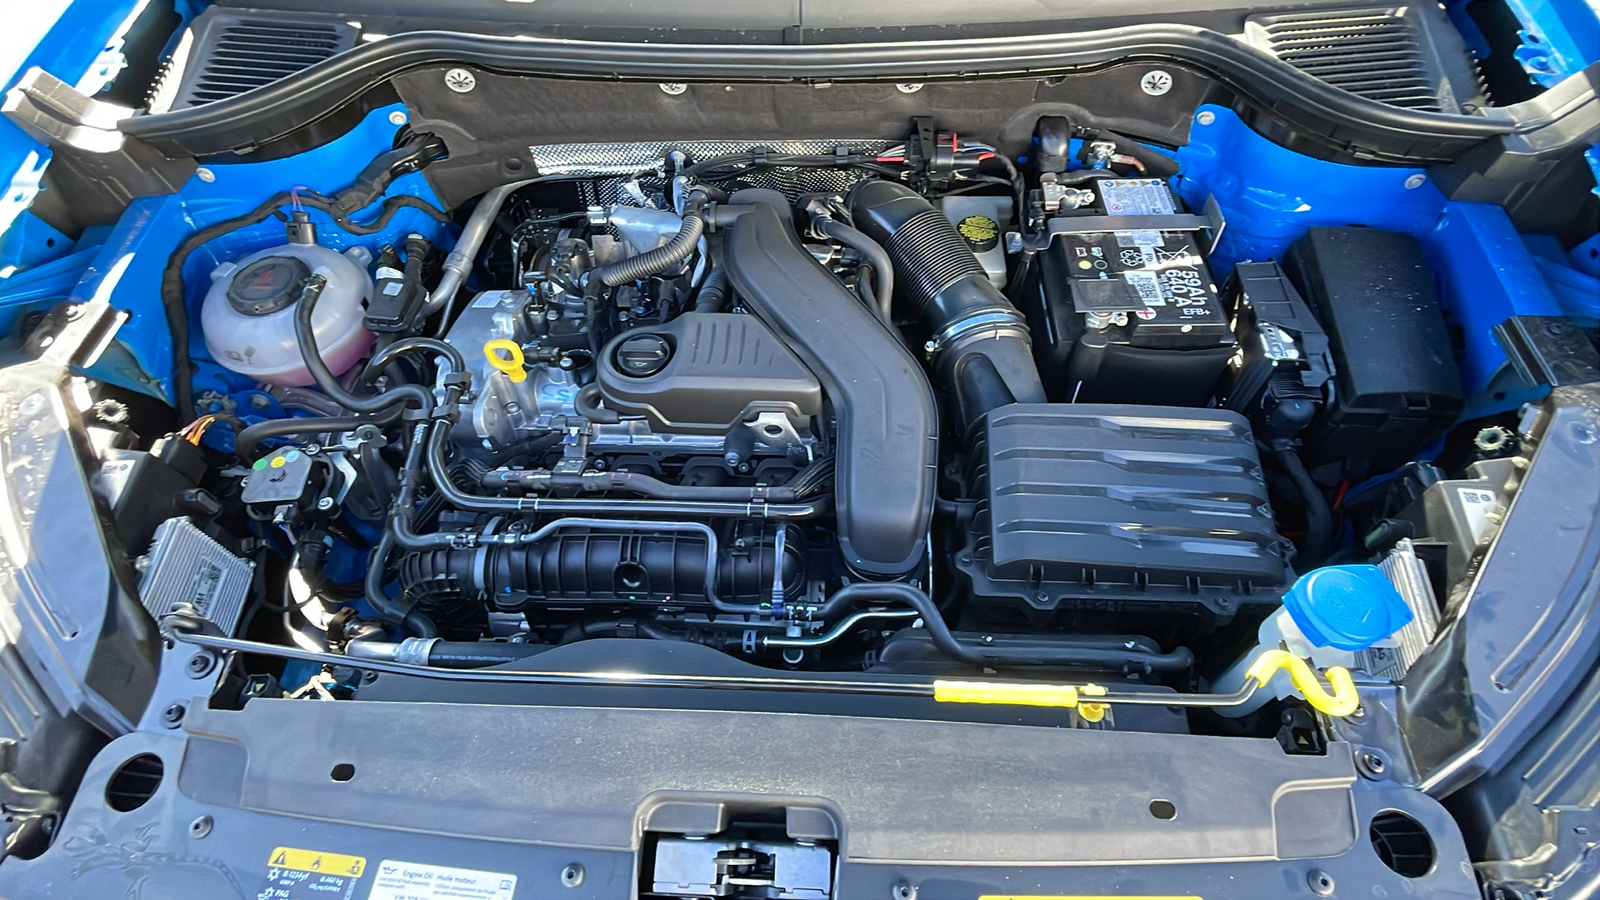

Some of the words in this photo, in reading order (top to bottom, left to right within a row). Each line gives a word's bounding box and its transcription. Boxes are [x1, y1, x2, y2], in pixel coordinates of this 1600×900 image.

[1165, 269, 1188, 294] 640
[1181, 270, 1208, 306] 59Ah
[1173, 296, 1193, 307] A
[1182, 308, 1212, 316] EFB+
[403, 869, 423, 879] Engine
[423, 872, 434, 880] Oil
[437, 873, 453, 882] Huile
[453, 876, 477, 885] moteur
